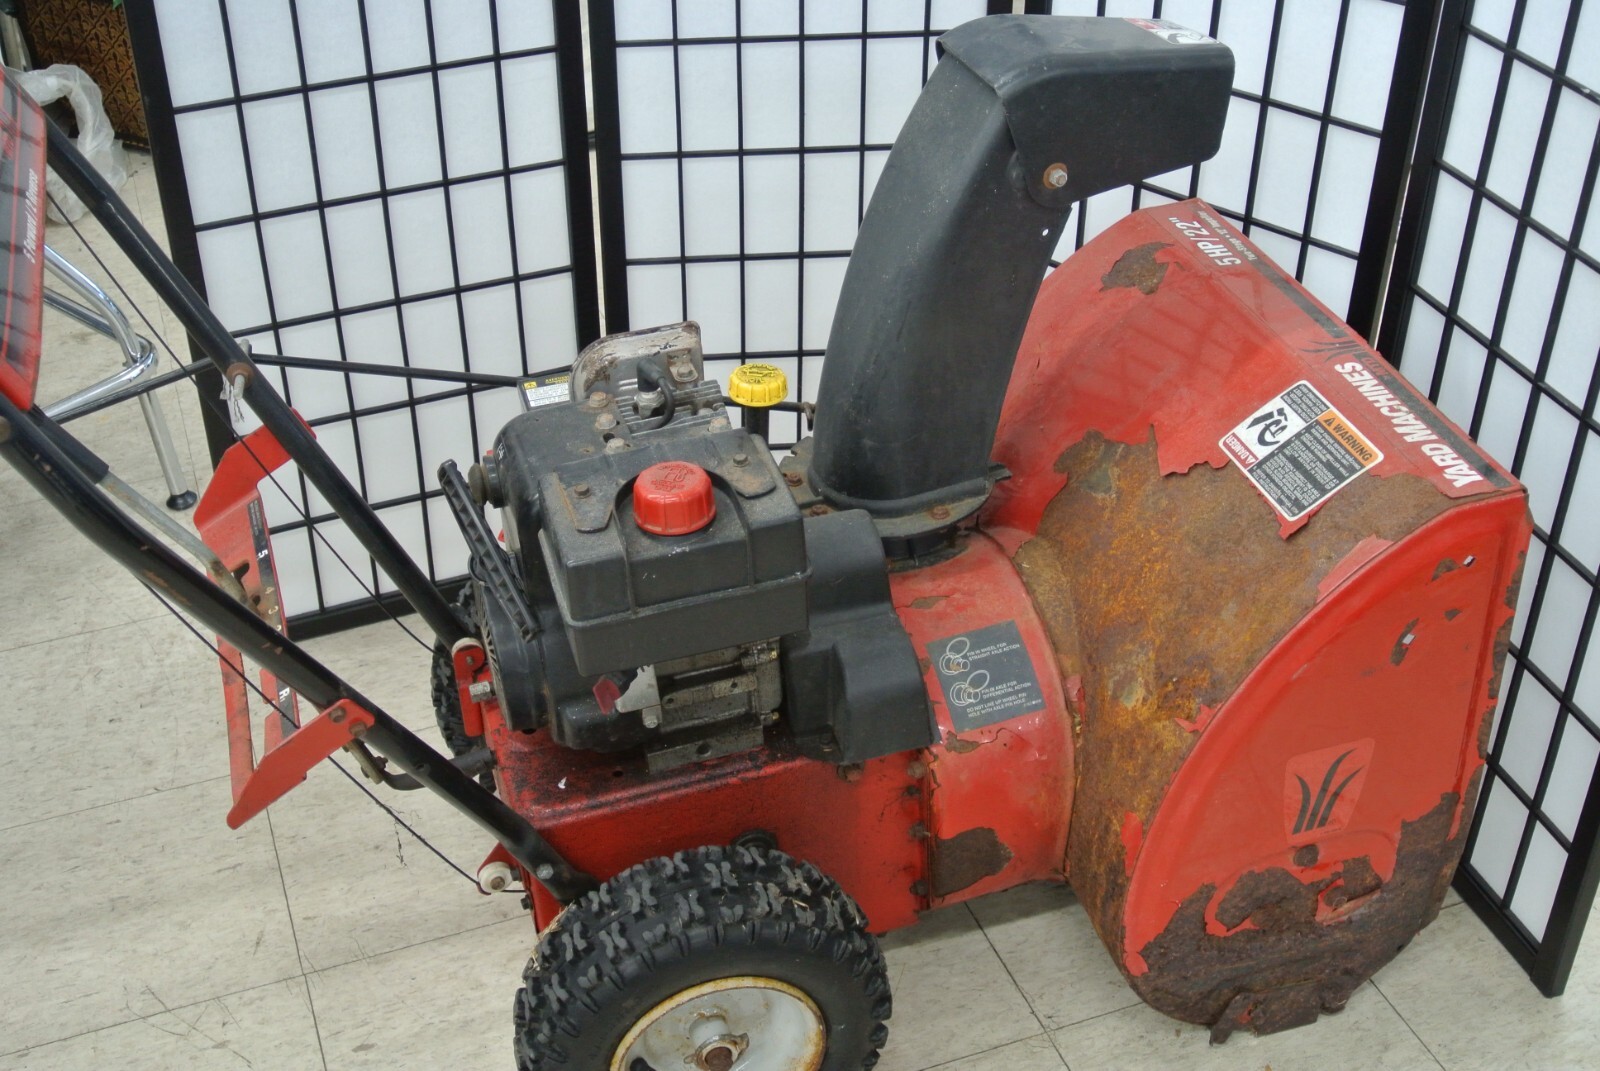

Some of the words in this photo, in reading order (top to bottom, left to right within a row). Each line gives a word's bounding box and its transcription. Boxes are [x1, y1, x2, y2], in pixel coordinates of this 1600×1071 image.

[1334, 361, 1438, 443] MACHINES
[1224, 434, 1249, 459] DANGER
[1331, 423, 1373, 462] WARNING
[1421, 444, 1484, 487] YARD
[257, 549, 268, 558] 5
[268, 605, 279, 615] 3
[968, 651, 990, 661] STRAIGHT
[1002, 643, 1020, 651] ACTION
[982, 686, 1013, 699] DIFFERENTIAL
[1013, 681, 1031, 690] ACTION
[1001, 694, 1017, 702] WHEEL
